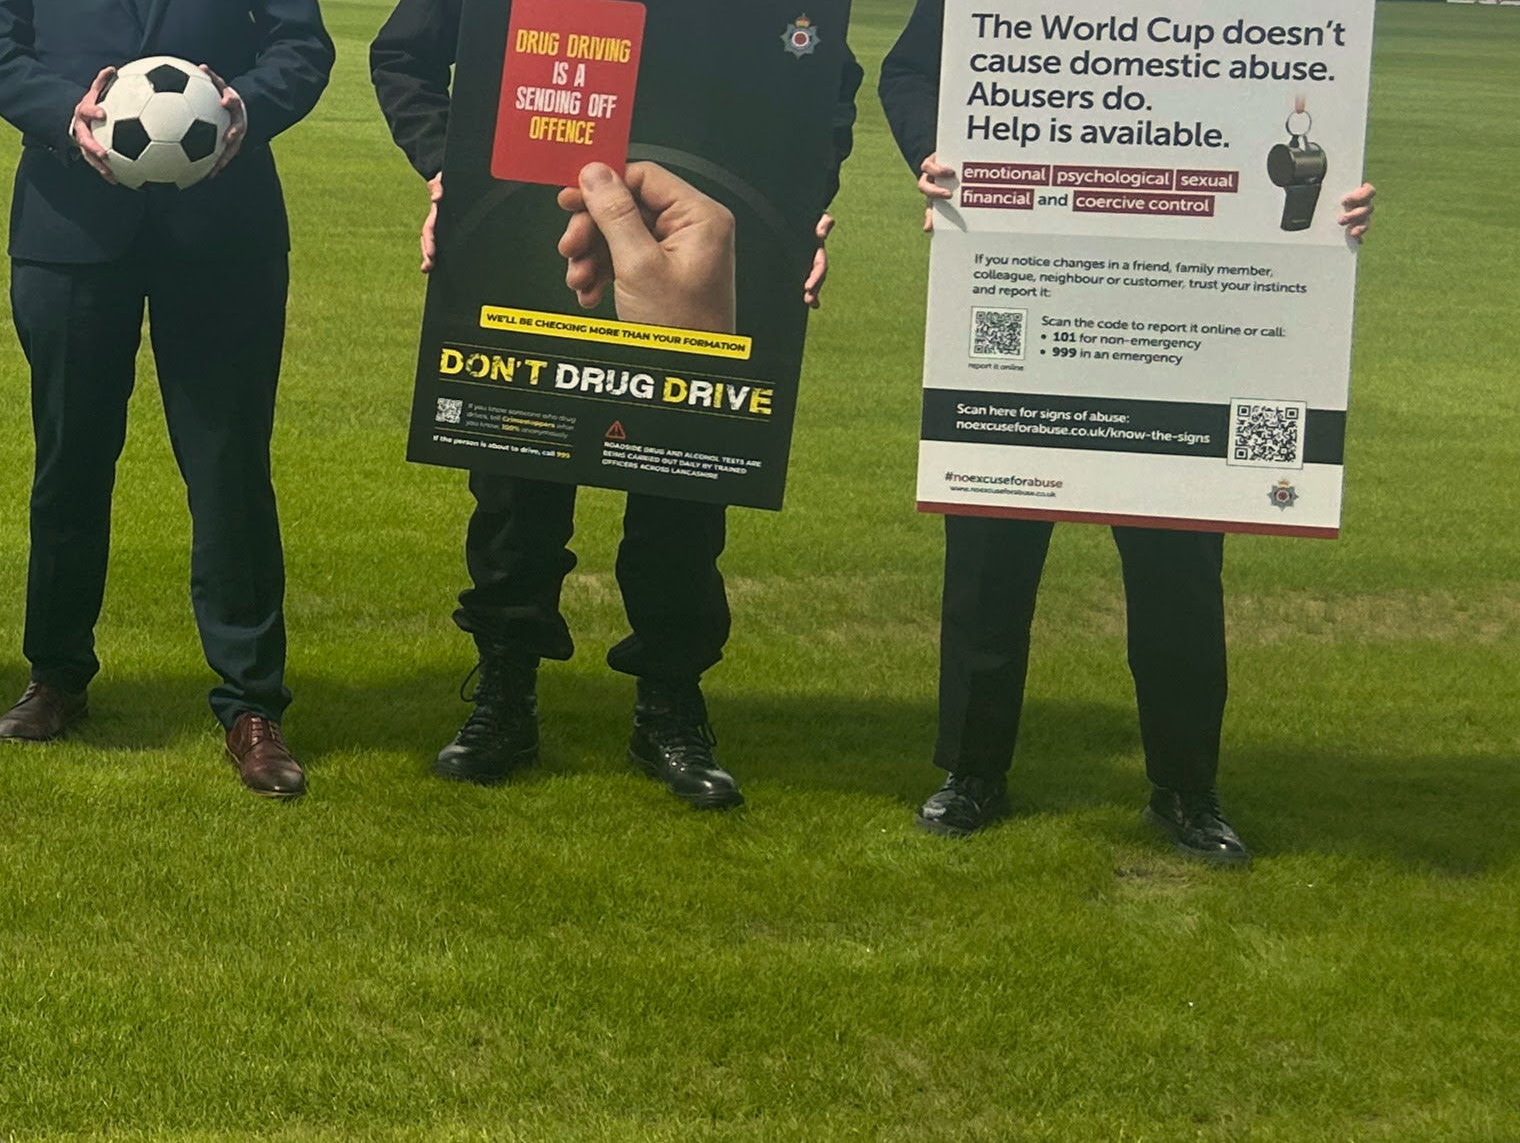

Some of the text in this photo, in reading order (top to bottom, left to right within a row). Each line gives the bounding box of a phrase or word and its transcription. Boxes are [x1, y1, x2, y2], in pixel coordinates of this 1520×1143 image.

[972, 13, 1346, 49] The World Cup doesn't
[516, 29, 631, 63] DRUG DRIVING
[552, 61, 586, 87] IS A
[970, 50, 1335, 82] cause domestic abuse.
[516, 86, 617, 119] SENDING OFF
[967, 82, 1152, 111] Abusers do.
[529, 116, 595, 145] OFFENCE
[968, 115, 1229, 148] Help is available.
[963, 166, 1233, 187] emotional psychological sexual
[962, 189, 1209, 212] financial and coercive control
[974, 254, 1273, 277] If you notice changes in a friend, family member,
[973, 269, 1307, 294] colleague, neighbour or customer, trust your instincts
[973, 285, 996, 296] and
[999, 286, 1037, 299] report
[519, 317, 533, 327] BE
[535, 318, 587, 333] CHECKING
[589, 326, 620, 337] MORE
[622, 329, 651, 340] THAN
[653, 332, 682, 345] YOUR
[683, 337, 746, 352] FORMATION
[1042, 315, 1072, 327] Scan
[1074, 317, 1094, 328] the
[1097, 318, 1128, 330] code
[1132, 320, 1144, 331] to
[1147, 321, 1188, 335] report
[1190, 322, 1199, 333] it
[1201, 323, 1240, 335] online
[1243, 327, 1257, 336] or
[1054, 331, 1201, 350] 101 for non-emergency
[1052, 346, 1183, 365] 999 in an emergency
[438, 348, 774, 415] DON'T DRUG DRIVE
[957, 403, 1130, 424] Scan here for signs of abuse:
[956, 419, 1211, 444] noexcuseforabuse.co.uk/know-the-signs
[644, 446, 665, 455] DRUG
[666, 449, 683, 457] AND
[684, 452, 720, 462] ALCOHOL
[722, 456, 744, 465] TESTS
[746, 460, 762, 468] ARE
[945, 471, 1063, 488] #noexcuseforabuse
